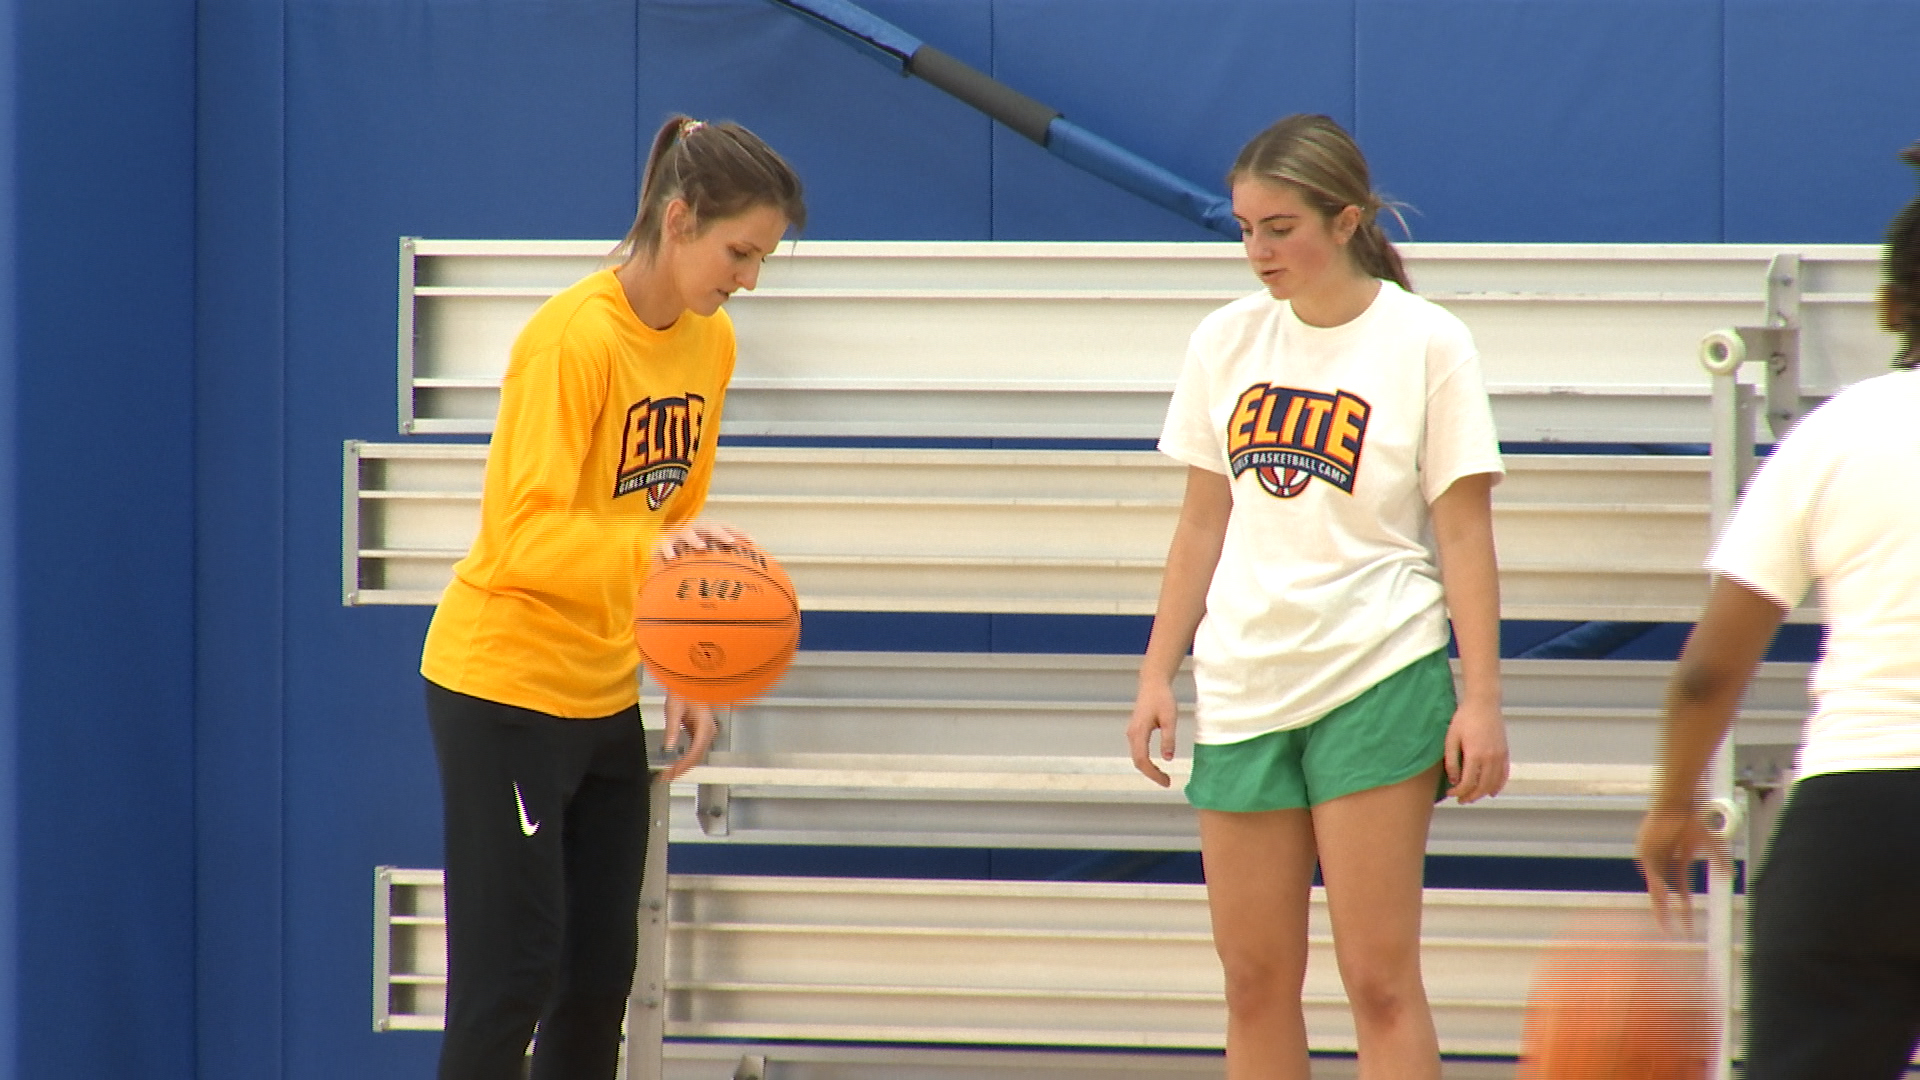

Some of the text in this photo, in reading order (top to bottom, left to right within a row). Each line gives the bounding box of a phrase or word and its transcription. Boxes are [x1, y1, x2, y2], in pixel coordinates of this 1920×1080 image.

[620, 398, 704, 473] ELITE
[1229, 386, 1366, 468] ELITE
[1252, 452, 1316, 471] BASKETBALL
[1318, 463, 1348, 484] CAMP
[619, 475, 645, 495] GIRLS
[676, 577, 744, 601] EVO
